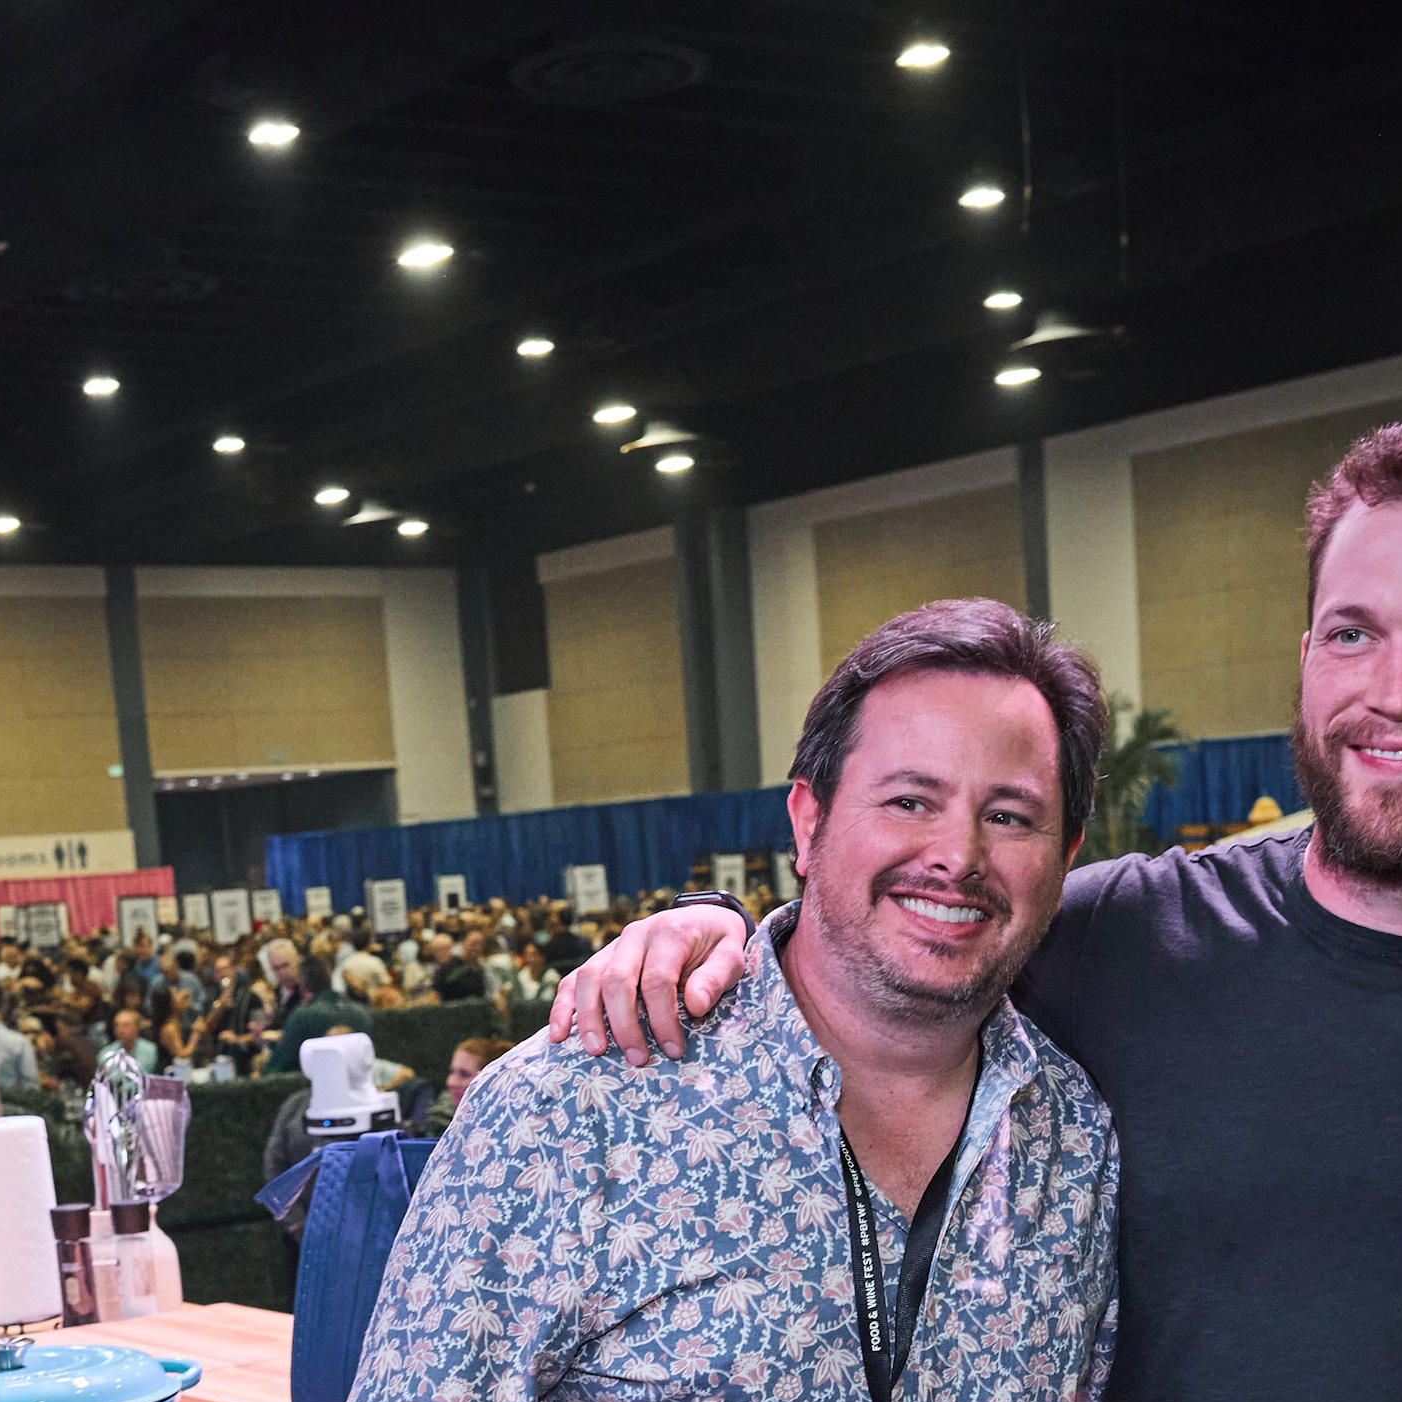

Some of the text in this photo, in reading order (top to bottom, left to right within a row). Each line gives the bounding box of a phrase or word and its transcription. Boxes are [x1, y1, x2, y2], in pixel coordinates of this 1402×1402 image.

[856, 1202, 871, 1247] #PBFWF
[862, 1251, 874, 1279] FEST
[865, 1280, 877, 1310] WINE
[868, 1310, 879, 1319] &
[869, 1320, 881, 1352] FOOD
